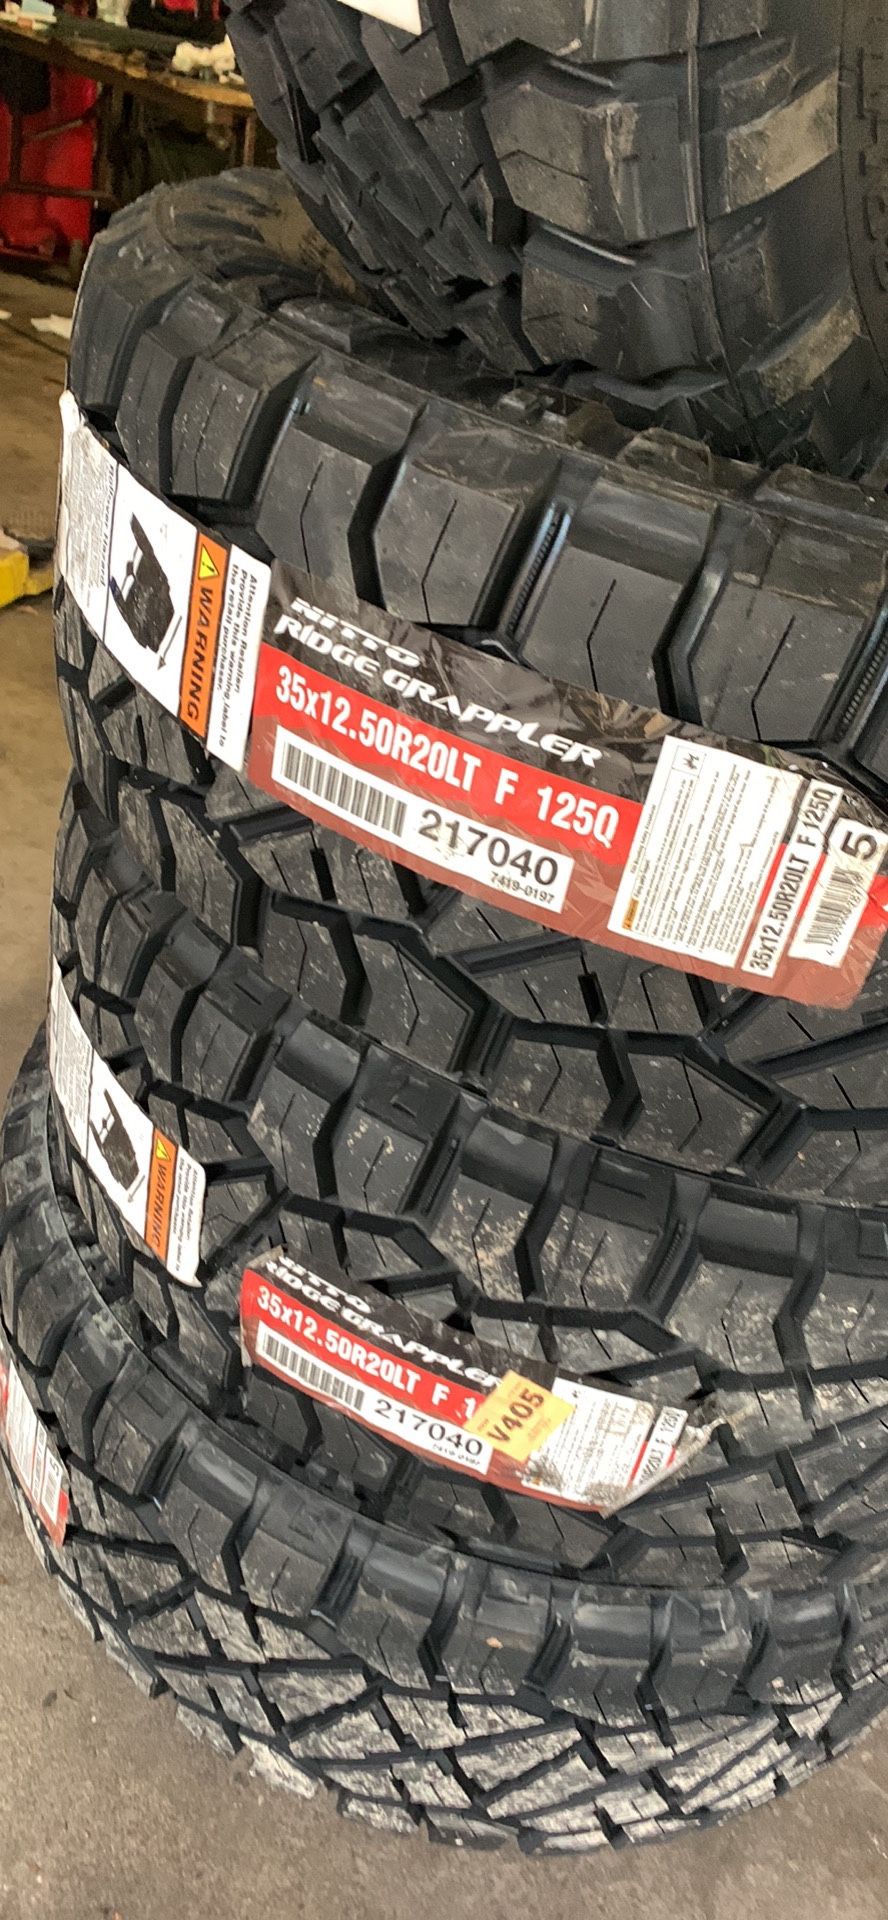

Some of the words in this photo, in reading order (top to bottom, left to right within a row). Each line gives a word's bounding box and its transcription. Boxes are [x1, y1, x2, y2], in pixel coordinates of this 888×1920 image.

[230, 564, 239, 586] the
[235, 569, 248, 618] Provide
[224, 589, 235, 625] retail
[241, 574, 258, 636] Attention
[187, 587, 213, 720] WARNING
[231, 623, 241, 646] this
[290, 597, 422, 668] NITTO
[216, 626, 230, 692] purchaser.
[223, 651, 236, 700] warning
[273, 614, 380, 678] RIDGE
[382, 668, 602, 768] GRAPPLER
[218, 735, 227, 747] to
[221, 702, 231, 733] label
[275, 665, 481, 792] 35x12.50R20LT
[494, 767, 519, 805] F
[536, 785, 620, 849] 125Q
[803, 788, 837, 829] 125Q
[418, 809, 559, 886] 217040
[796, 834, 816, 848] F
[840, 831, 878, 861] 5
[490, 871, 556, 904] 7419-0197
[750, 853, 809, 971] 35x12.50R20LT
[256, 1285, 422, 1395] 35x12.50R20LT
[431, 1382, 451, 1407] F
[374, 1398, 483, 1456] 217040
[487, 1387, 545, 1443] V405
